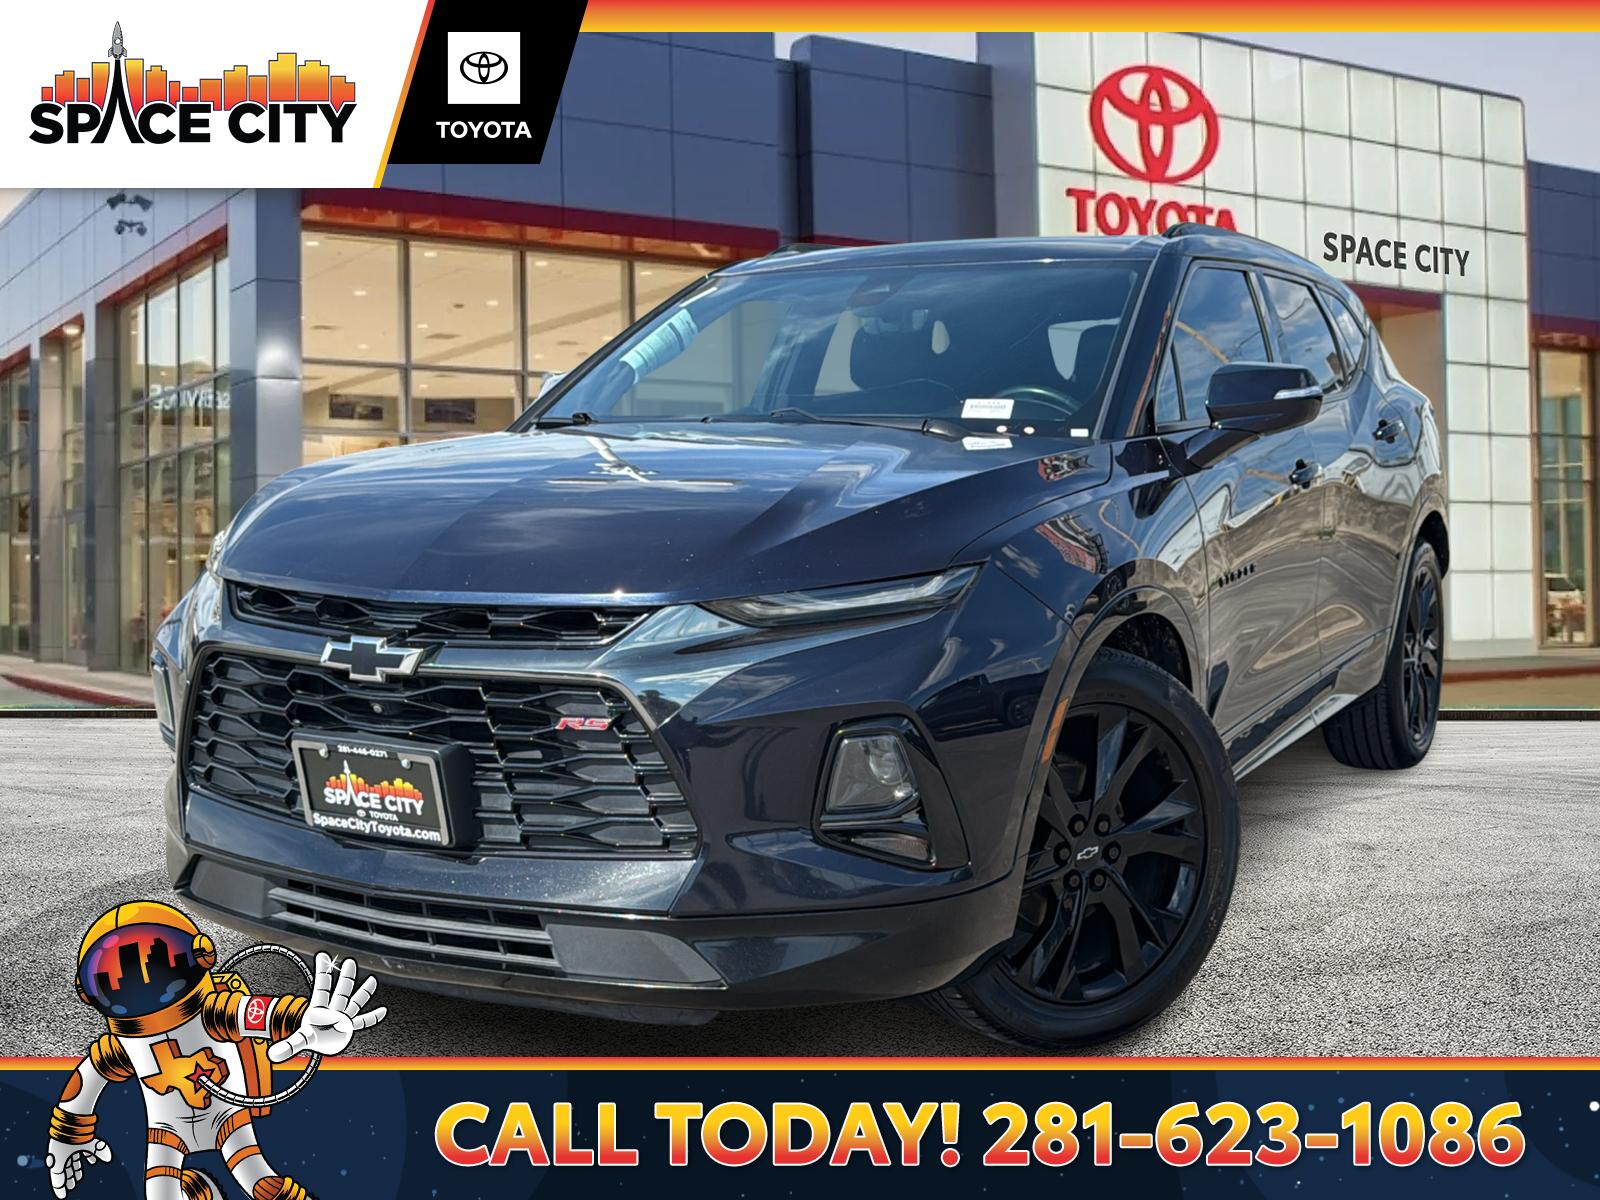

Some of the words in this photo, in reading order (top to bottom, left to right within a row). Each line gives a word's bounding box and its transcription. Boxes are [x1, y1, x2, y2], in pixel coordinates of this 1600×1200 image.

[1066, 188, 1238, 236] TOYOTA
[1323, 232, 1408, 270] SPACE
[1415, 244, 1470, 277] CITY
[555, 717, 612, 731] RS
[323, 773, 382, 810] SPACE
[384, 794, 424, 816] CITY
[313, 812, 441, 842] SpaceCityToyota.com
[369, 810, 399, 822] TOYOTA
